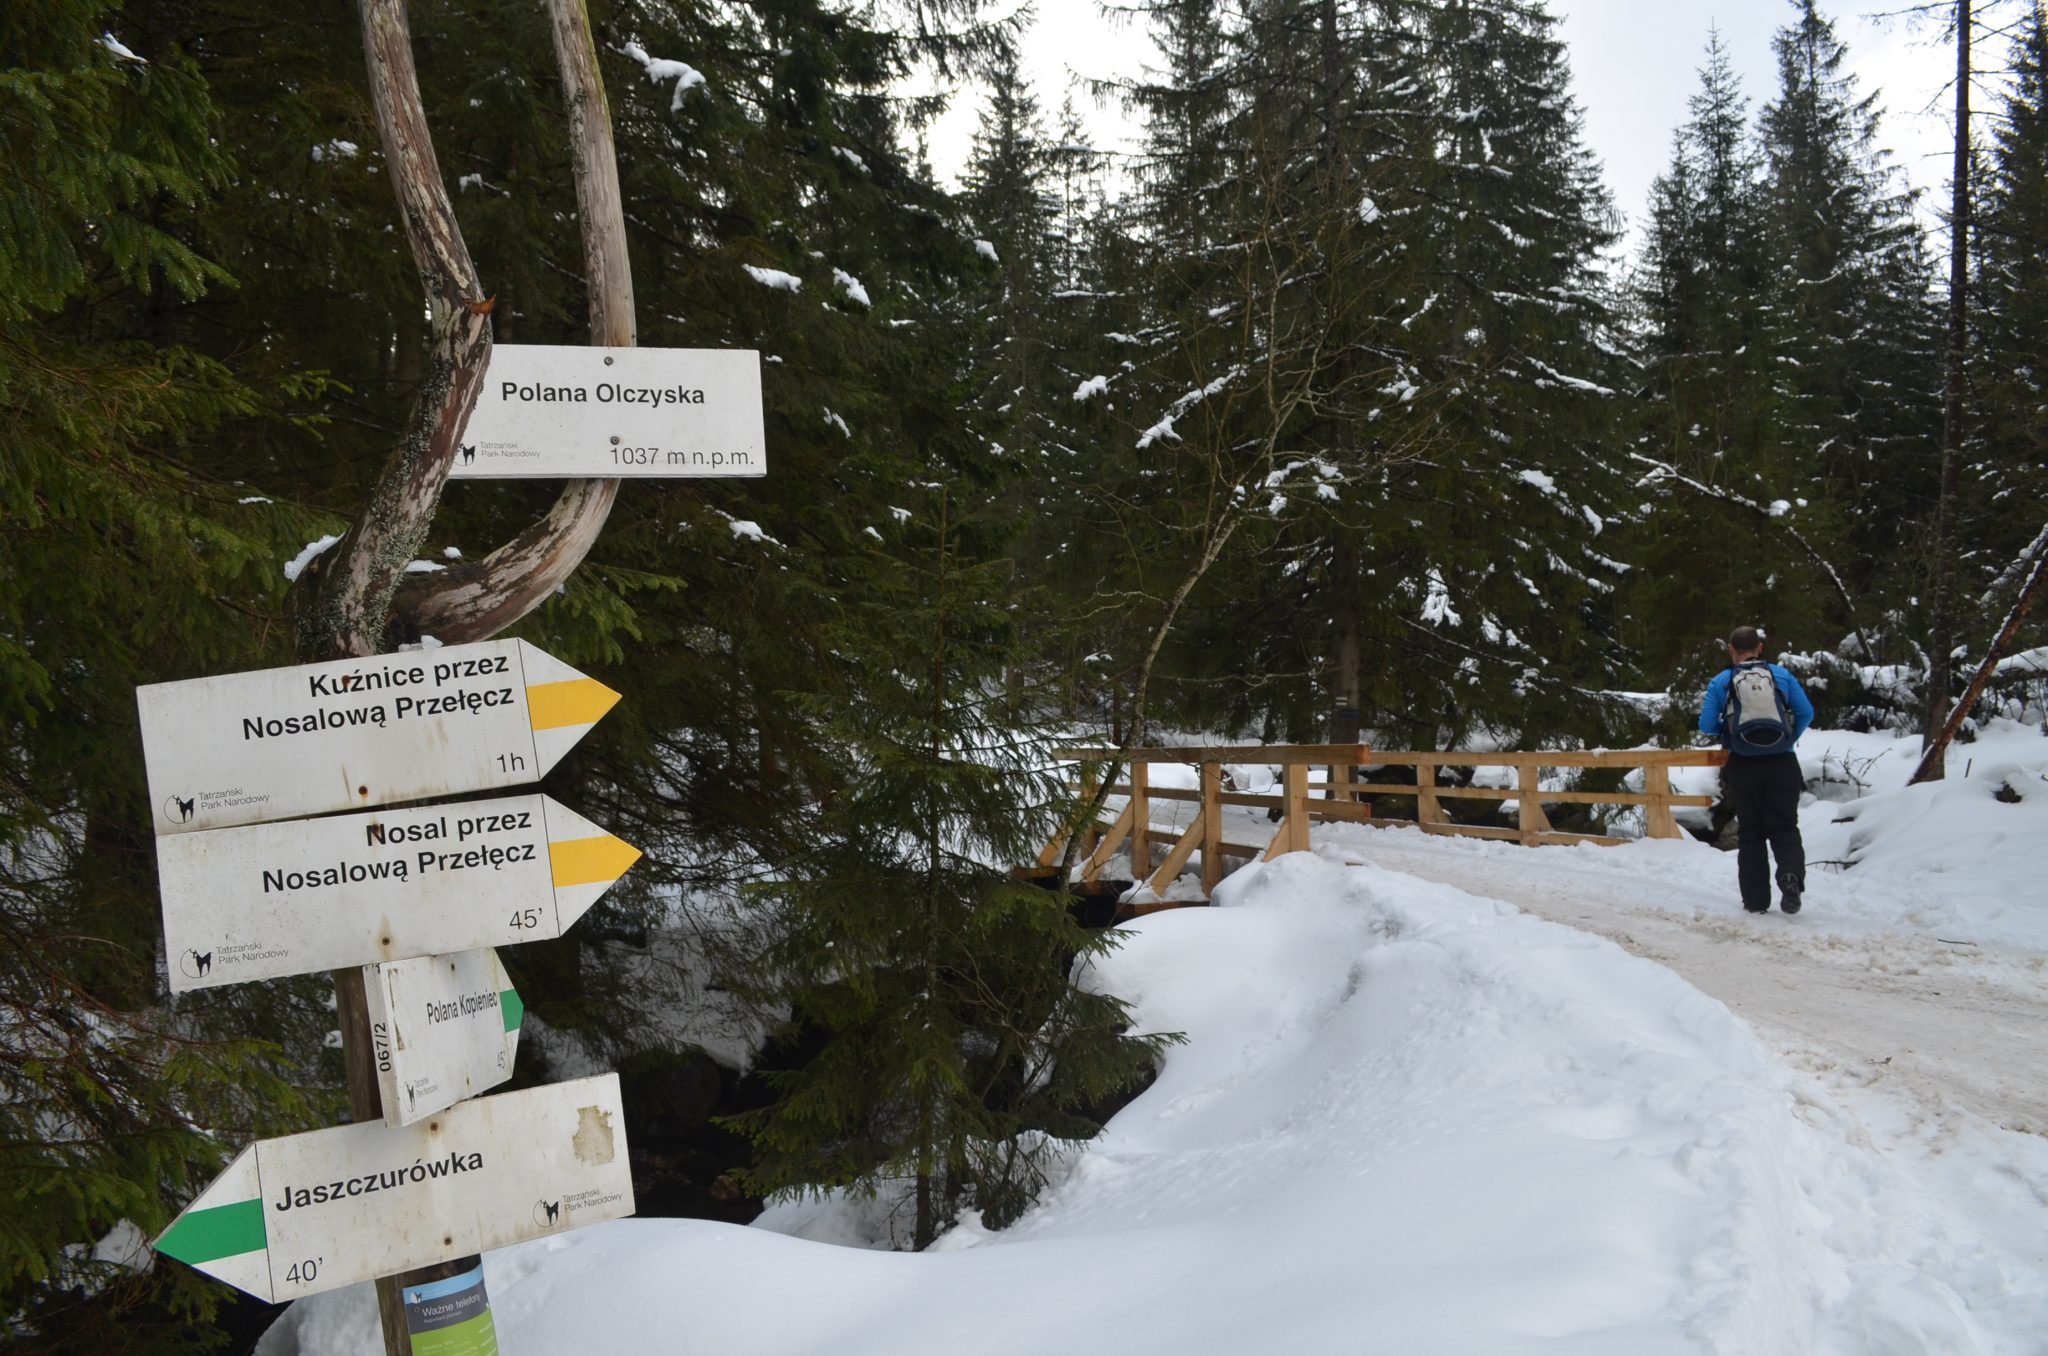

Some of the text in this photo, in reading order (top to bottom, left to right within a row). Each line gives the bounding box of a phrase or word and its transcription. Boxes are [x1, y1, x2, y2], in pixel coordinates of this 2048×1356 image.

[501, 381, 705, 408] Polana Olczyska
[481, 450, 540, 459] Park Narodowy
[610, 447, 755, 468] 1037 m n.p.m.
[309, 655, 510, 698] Kuźnice przez
[242, 687, 514, 740] Nosalową Przełęcz
[497, 752, 526, 774] 1h
[198, 787, 243, 801] Tatrzański
[201, 794, 270, 811] Park Narodowy
[366, 812, 532, 847] Nosal przez
[262, 842, 536, 893] Nosalową Przełęcz
[216, 941, 262, 954] Tatrzański
[218, 949, 290, 965] Park Narodowy
[427, 989, 498, 1025] Polana Kopieniec
[374, 1022, 391, 1072] 067/2
[275, 1152, 484, 1212] Jaszczurówka
[562, 1187, 600, 1203] Tatrzański
[564, 1192, 624, 1213] Park Narodowy
[421, 1304, 454, 1317] Ważne
